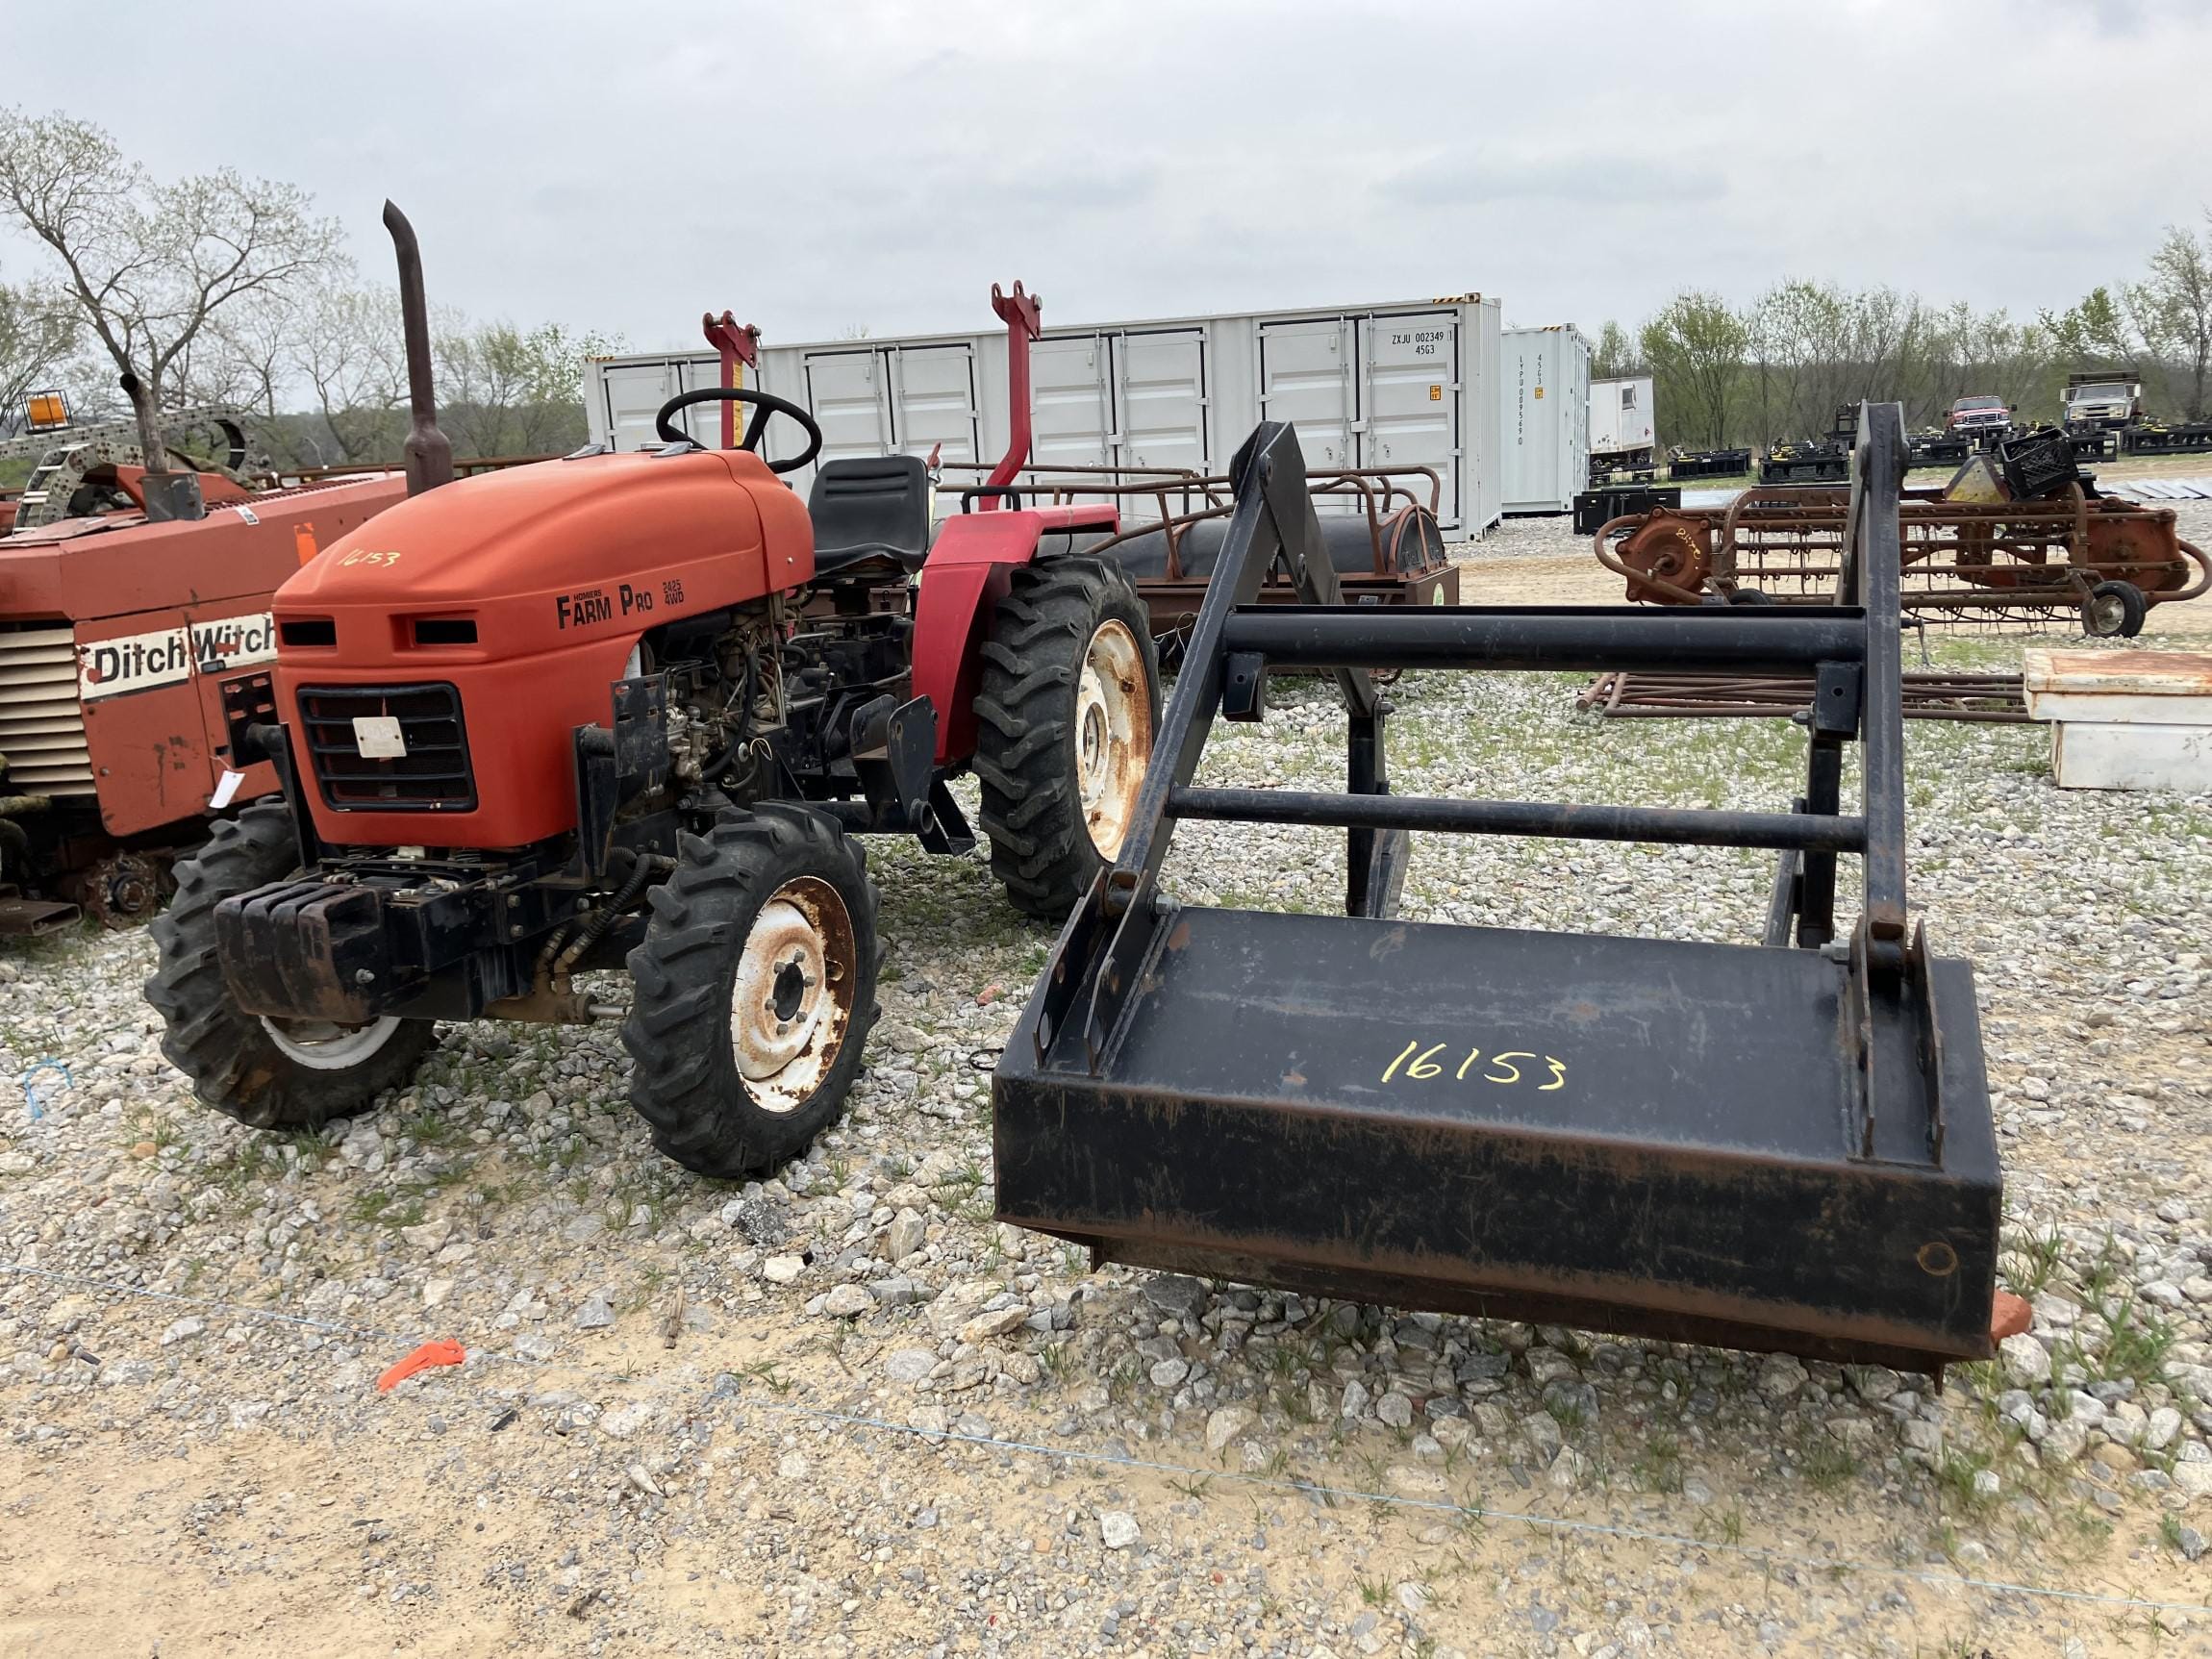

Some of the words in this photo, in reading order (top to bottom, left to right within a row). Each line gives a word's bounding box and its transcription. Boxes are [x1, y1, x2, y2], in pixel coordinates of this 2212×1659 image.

[1392, 334, 1411, 345] ZXJU
[1415, 331, 1445, 343] 002349
[1415, 344, 1436, 355] 45G3
[337, 548, 401, 567] 16153
[662, 579, 682, 593] 2425
[556, 594, 613, 630] FARM
[618, 584, 654, 616] PRO
[665, 591, 685, 606] 4WD
[94, 636, 187, 685] Ditch
[193, 617, 278, 662] Witch
[1381, 1041, 1568, 1091] 16153
